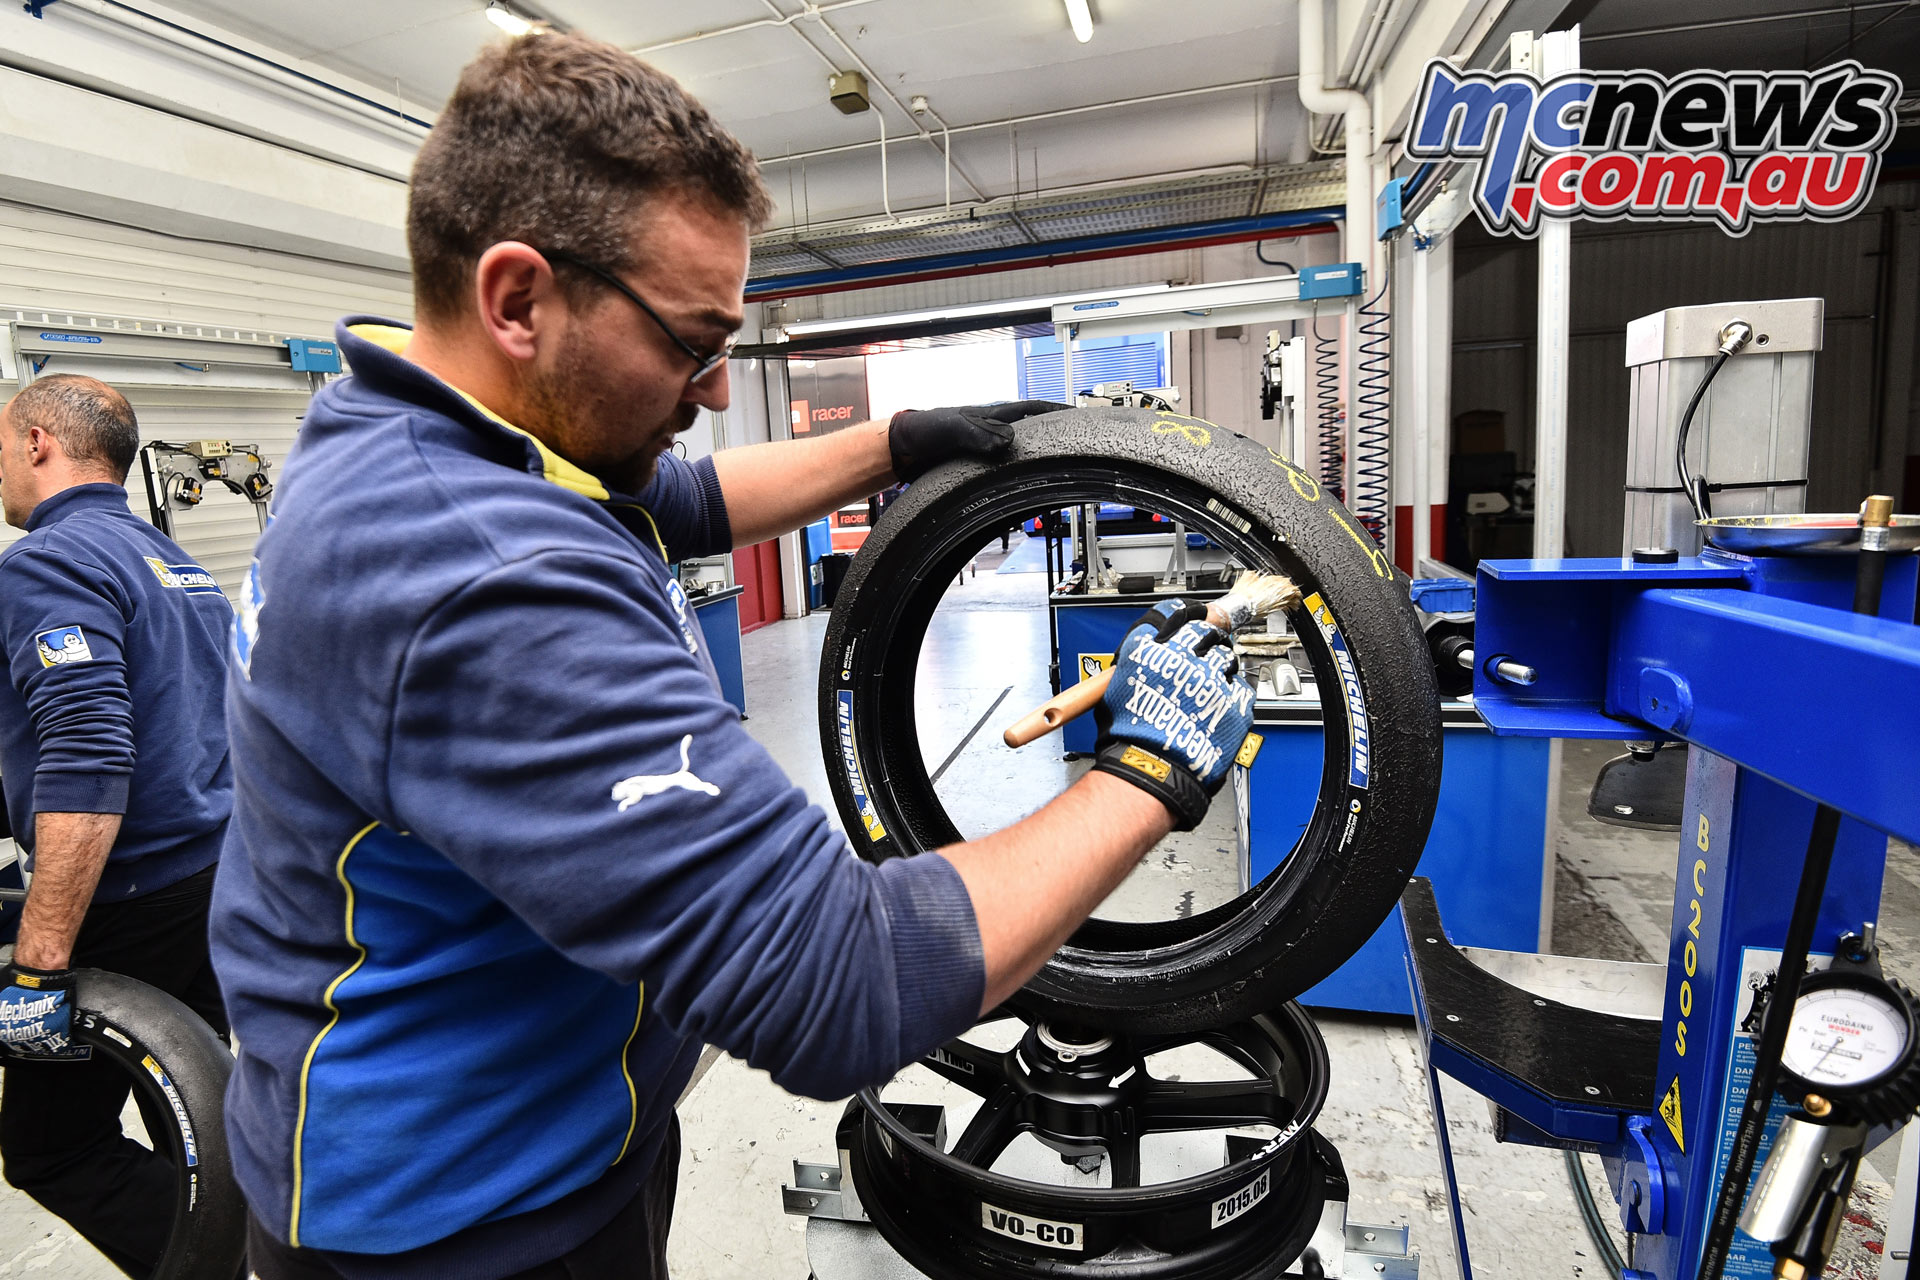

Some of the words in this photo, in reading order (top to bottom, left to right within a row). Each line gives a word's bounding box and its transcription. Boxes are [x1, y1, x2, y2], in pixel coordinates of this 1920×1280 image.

[811, 405, 854, 422] racer
[840, 513, 867, 525] racer
[1335, 649, 1368, 775] MICHELIN
[838, 700, 866, 797] MICHELIN
[1675, 813, 1710, 1058] BC200S
[164, 1085, 197, 1157] MICHELIN
[988, 1208, 1075, 1246] VO-CO
[1217, 1174, 1267, 1222] 2015.08
